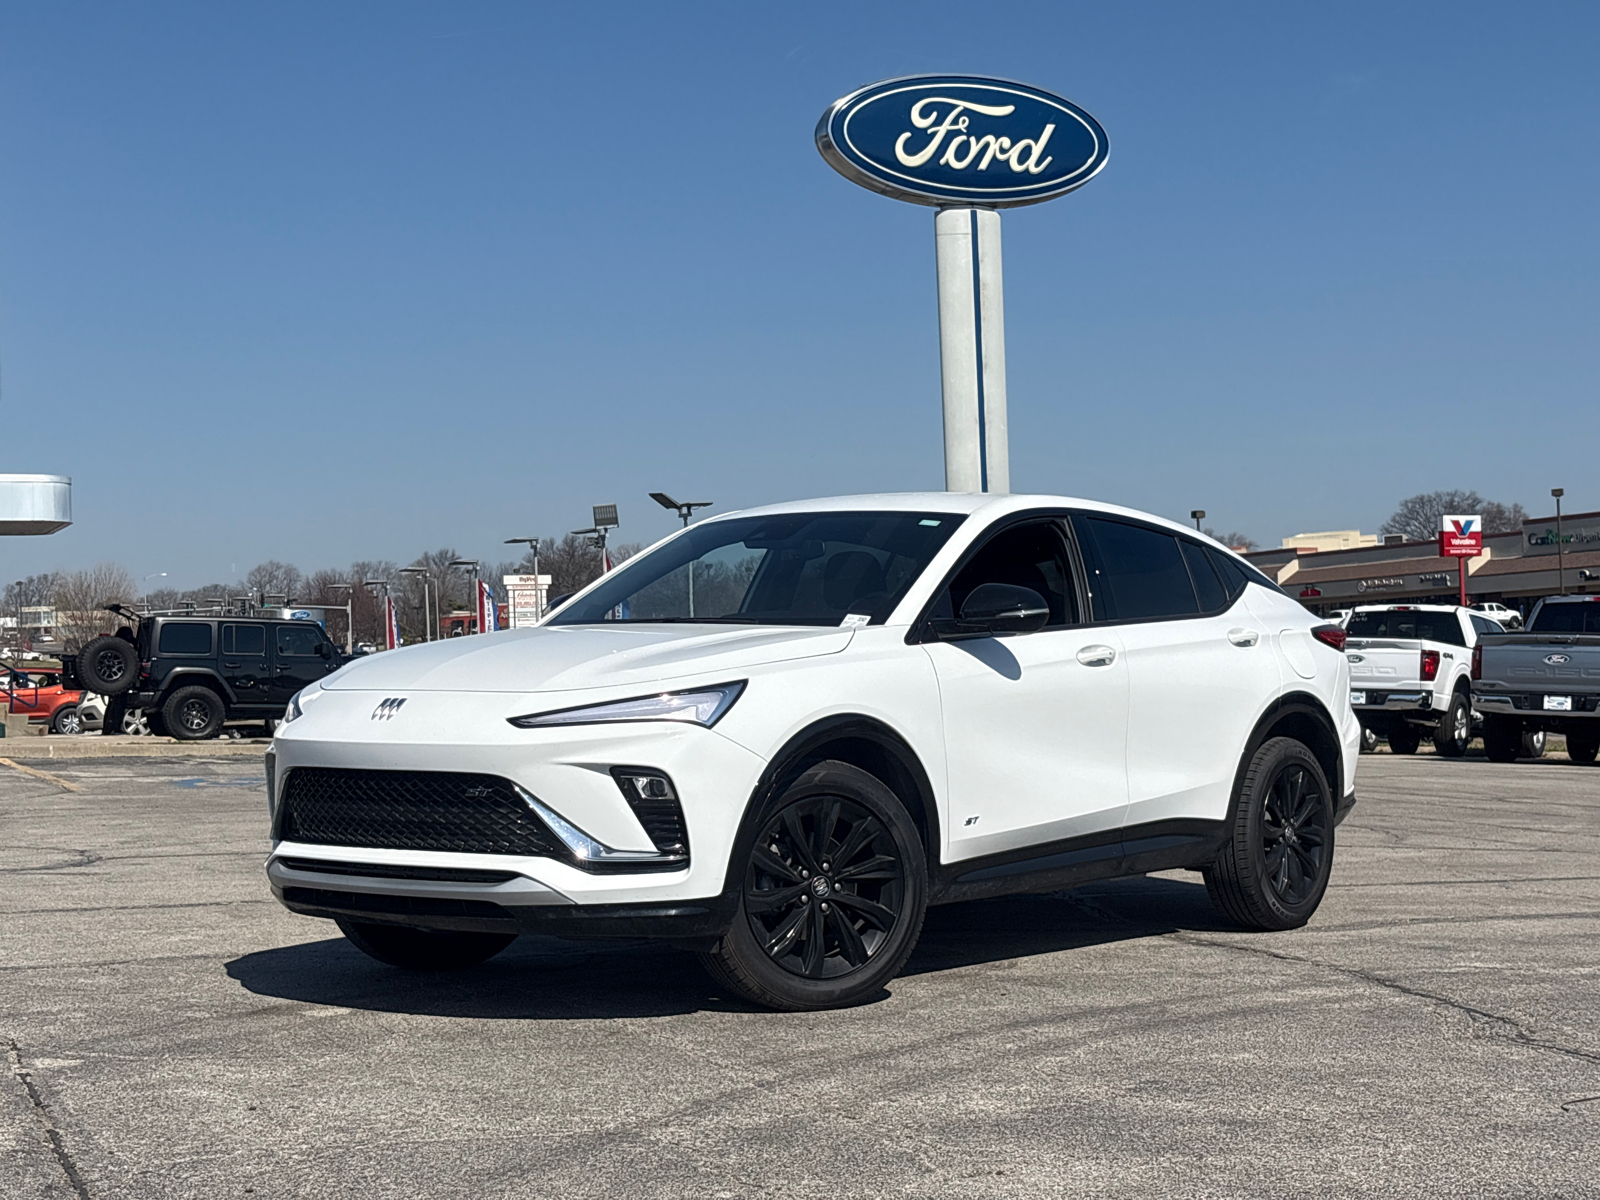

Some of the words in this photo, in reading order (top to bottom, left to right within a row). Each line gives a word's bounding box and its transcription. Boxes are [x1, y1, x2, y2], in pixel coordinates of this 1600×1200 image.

[894, 96, 1055, 174] Ford
[1450, 538, 1477, 546] Valvoline
[1549, 653, 1566, 664] Ford
[465, 788, 492, 797] ST
[964, 815, 980, 827] ST
